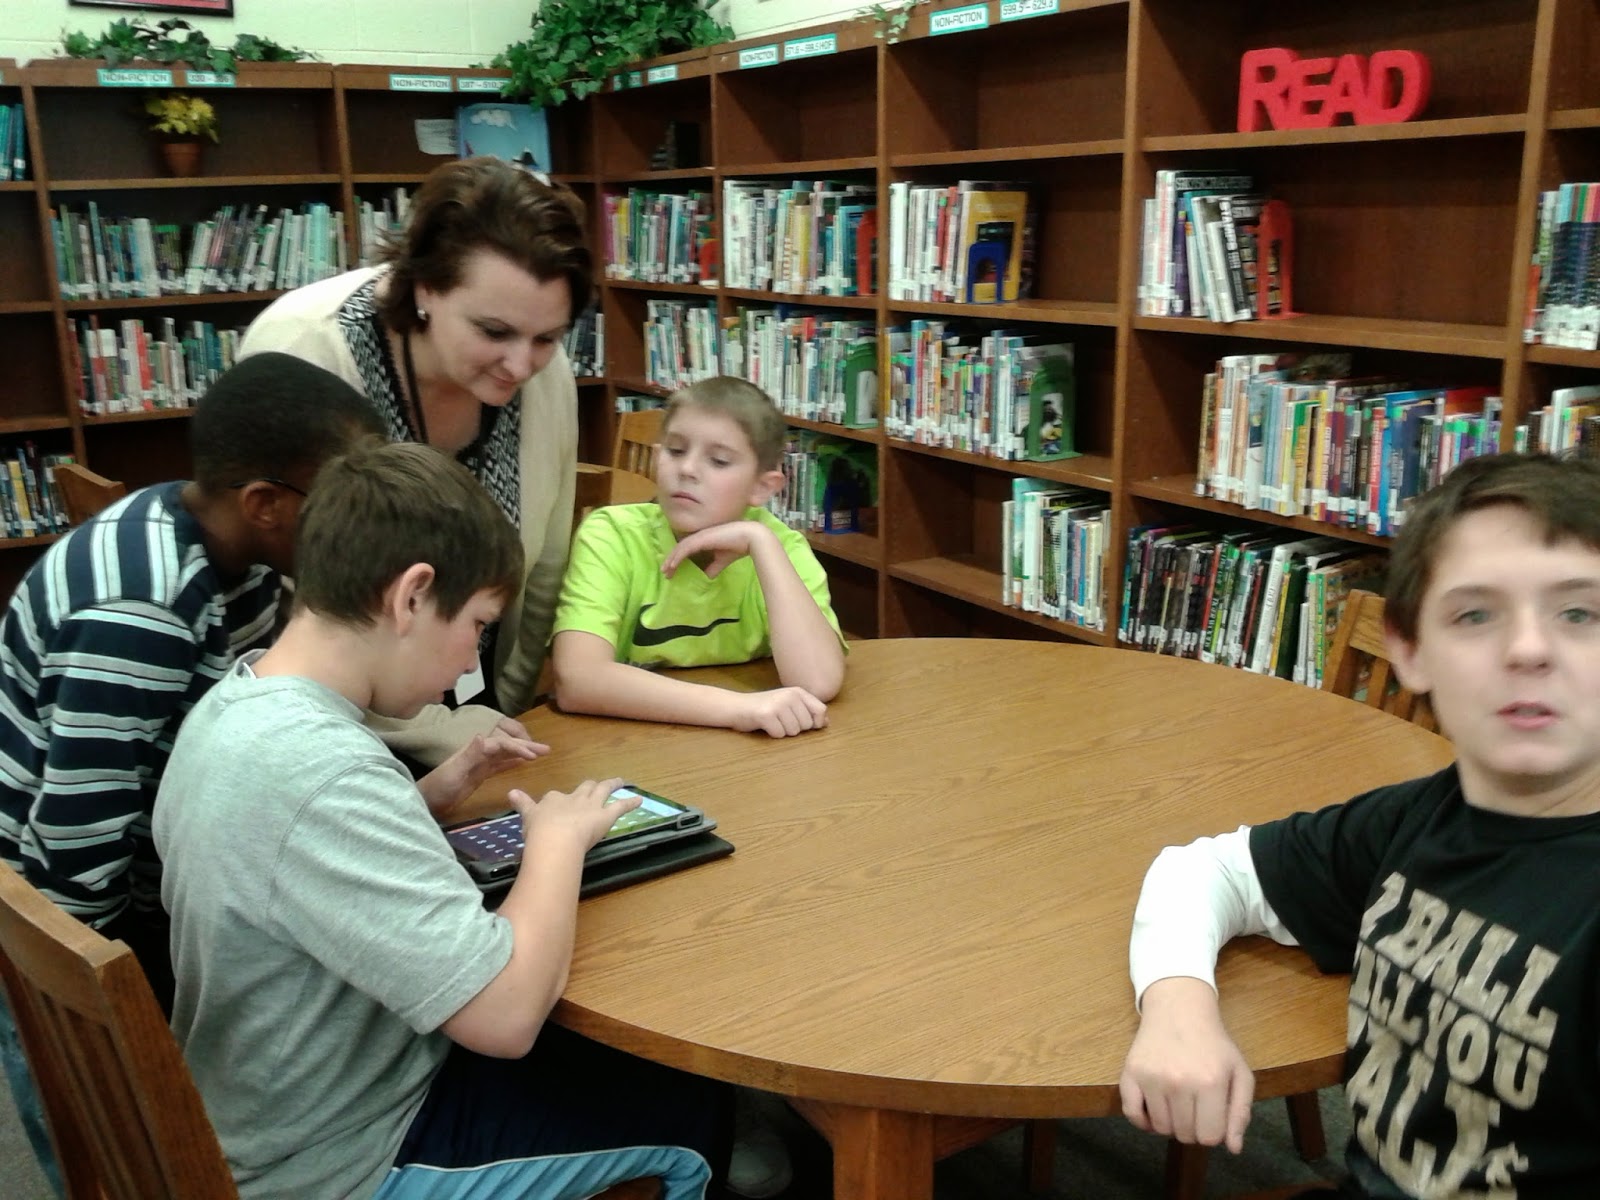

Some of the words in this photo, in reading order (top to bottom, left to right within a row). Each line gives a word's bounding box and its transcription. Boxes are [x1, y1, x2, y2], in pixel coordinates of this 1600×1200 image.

[934, 11, 983, 28] NON-FICTION
[102, 72, 168, 83] NON-FICTION
[392, 79, 449, 89] NON-FICTION
[1237, 47, 1431, 132] READ
[1373, 888, 1561, 1050] BALL
[1422, 989, 1549, 1112] YOU
